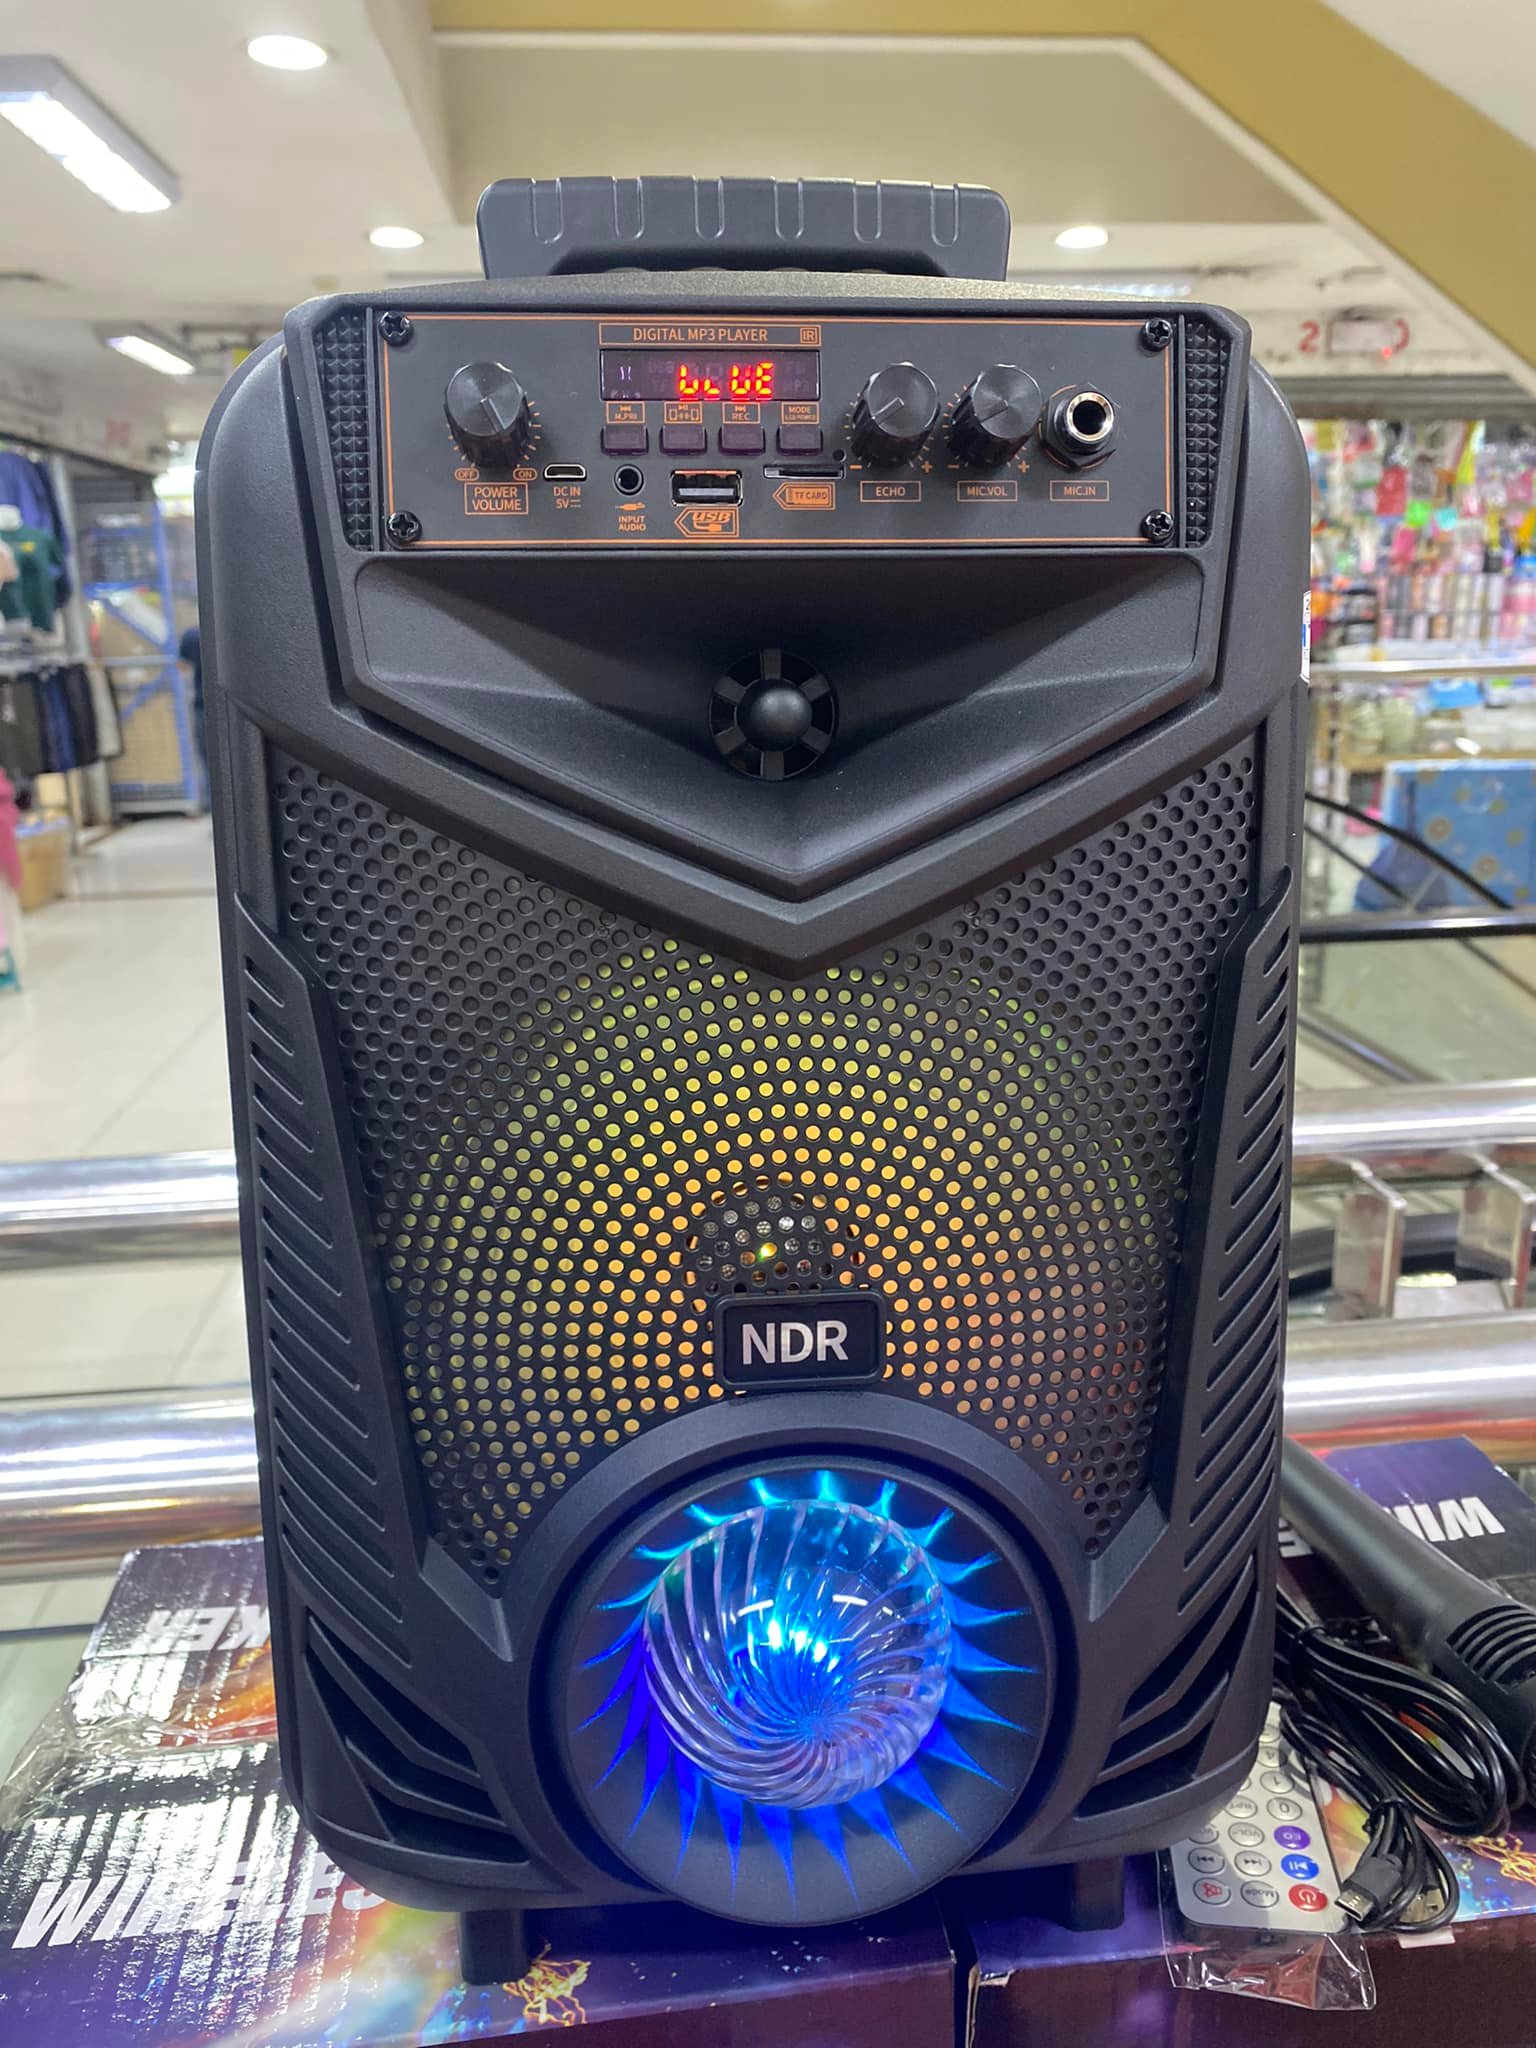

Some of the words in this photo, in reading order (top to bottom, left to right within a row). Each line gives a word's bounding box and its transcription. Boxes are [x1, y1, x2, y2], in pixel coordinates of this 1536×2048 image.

[633, 328, 684, 341] DIGITAL
[688, 328, 715, 341] MP3
[720, 329, 768, 341] PLAYER
[803, 330, 816, 341] IR
[789, 406, 811, 414] MODE
[732, 412, 750, 420] REC
[458, 470, 475, 478] OFF
[518, 470, 532, 478] ON
[474, 486, 518, 498] POWER
[553, 486, 568, 497] DC
[570, 486, 581, 496] IN
[794, 491, 804, 500] TF
[805, 491, 827, 500] CARD
[875, 486, 906, 496] ECHO
[967, 486, 1008, 496] MIC.VOL
[1063, 486, 1096, 496] MIC.IN
[472, 499, 522, 511] VOLUME
[618, 515, 645, 523] INPUT
[692, 511, 731, 523] USB
[618, 523, 646, 531] AUDIO
[742, 1320, 849, 1365] NDR
[1279, 1802, 1290, 1813] 0
[1282, 1831, 1302, 1841] EQ
[1244, 1887, 1275, 1899] Mode
